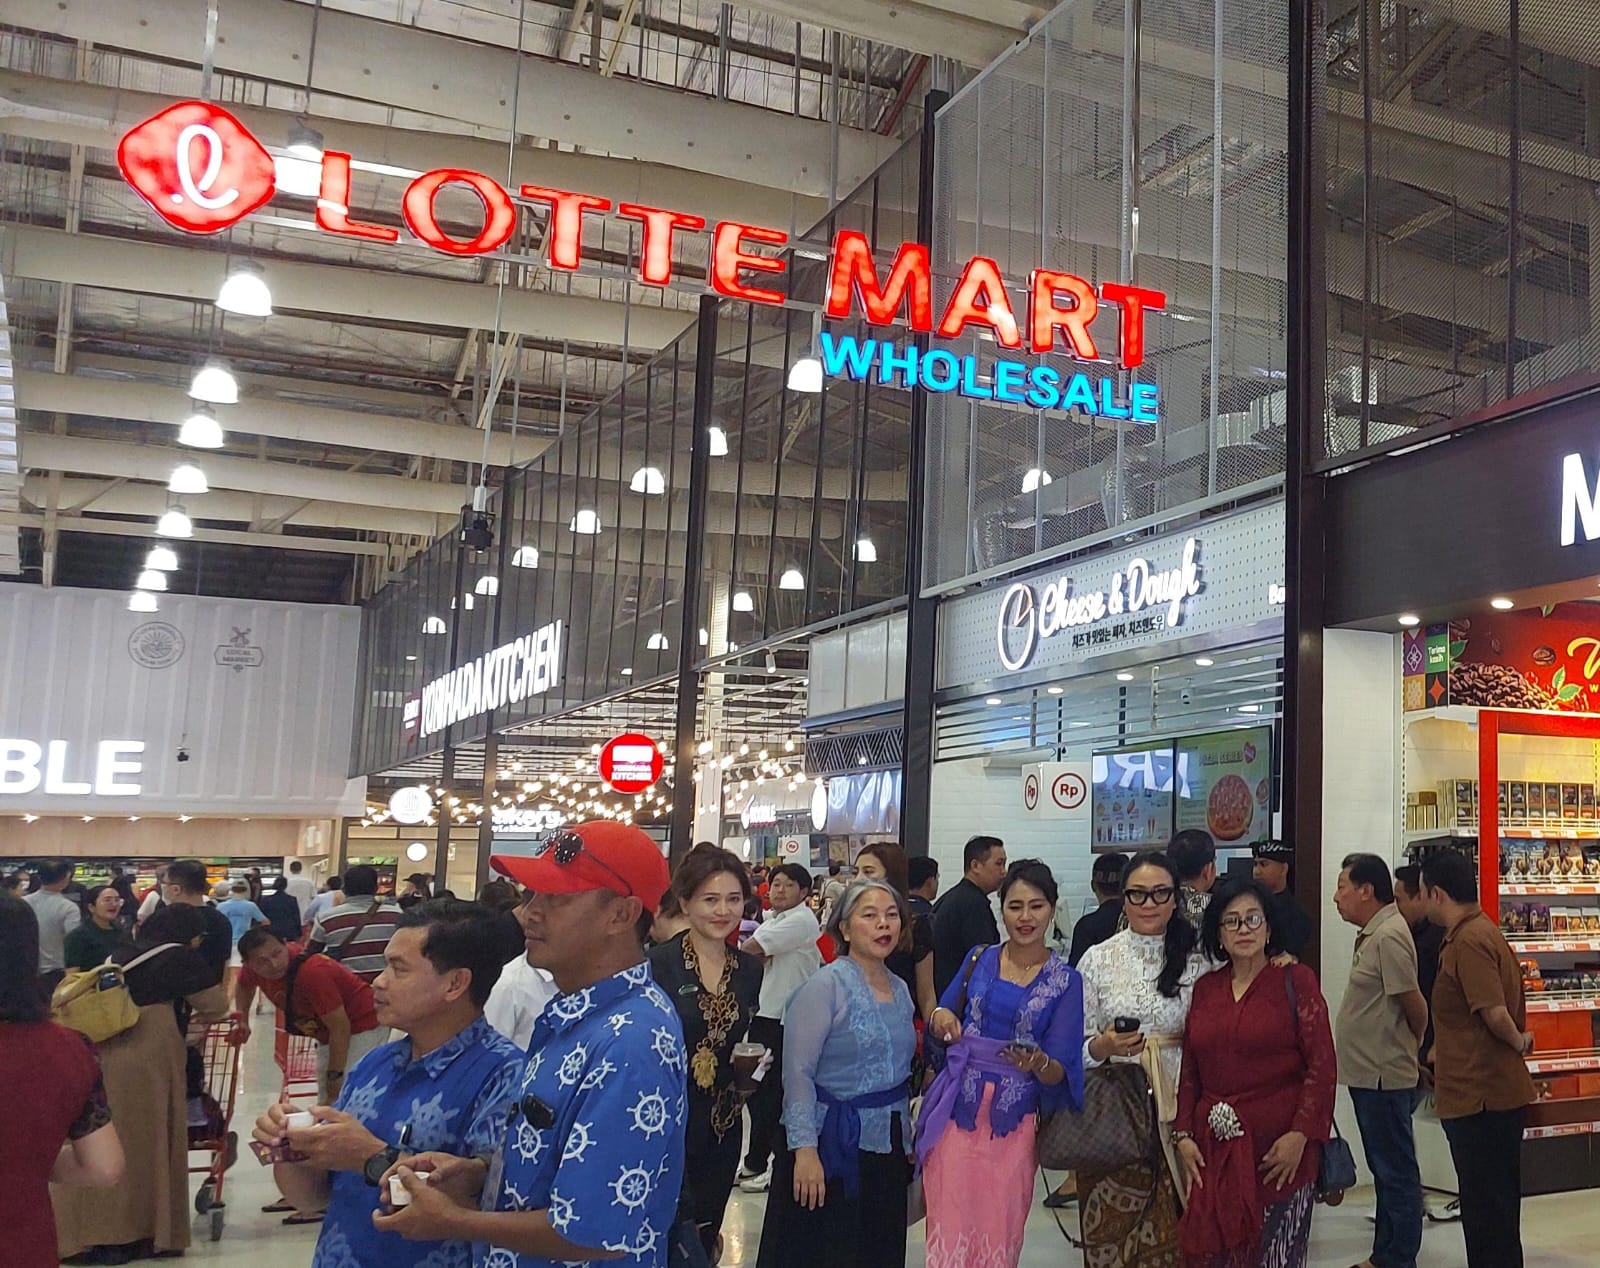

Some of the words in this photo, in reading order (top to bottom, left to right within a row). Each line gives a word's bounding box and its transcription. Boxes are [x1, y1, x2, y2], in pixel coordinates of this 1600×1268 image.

[315, 149, 788, 305] LOTTE
[823, 229, 1167, 369] MART
[820, 331, 1160, 424] WHOLESALE
[1038, 576, 1107, 638] Cheese
[1108, 572, 1124, 616] &
[1125, 537, 1201, 628] Dough
[481, 619, 562, 714] KITCHEN
[0, 738, 145, 796] BLE
[1060, 783, 1079, 798] Rp
